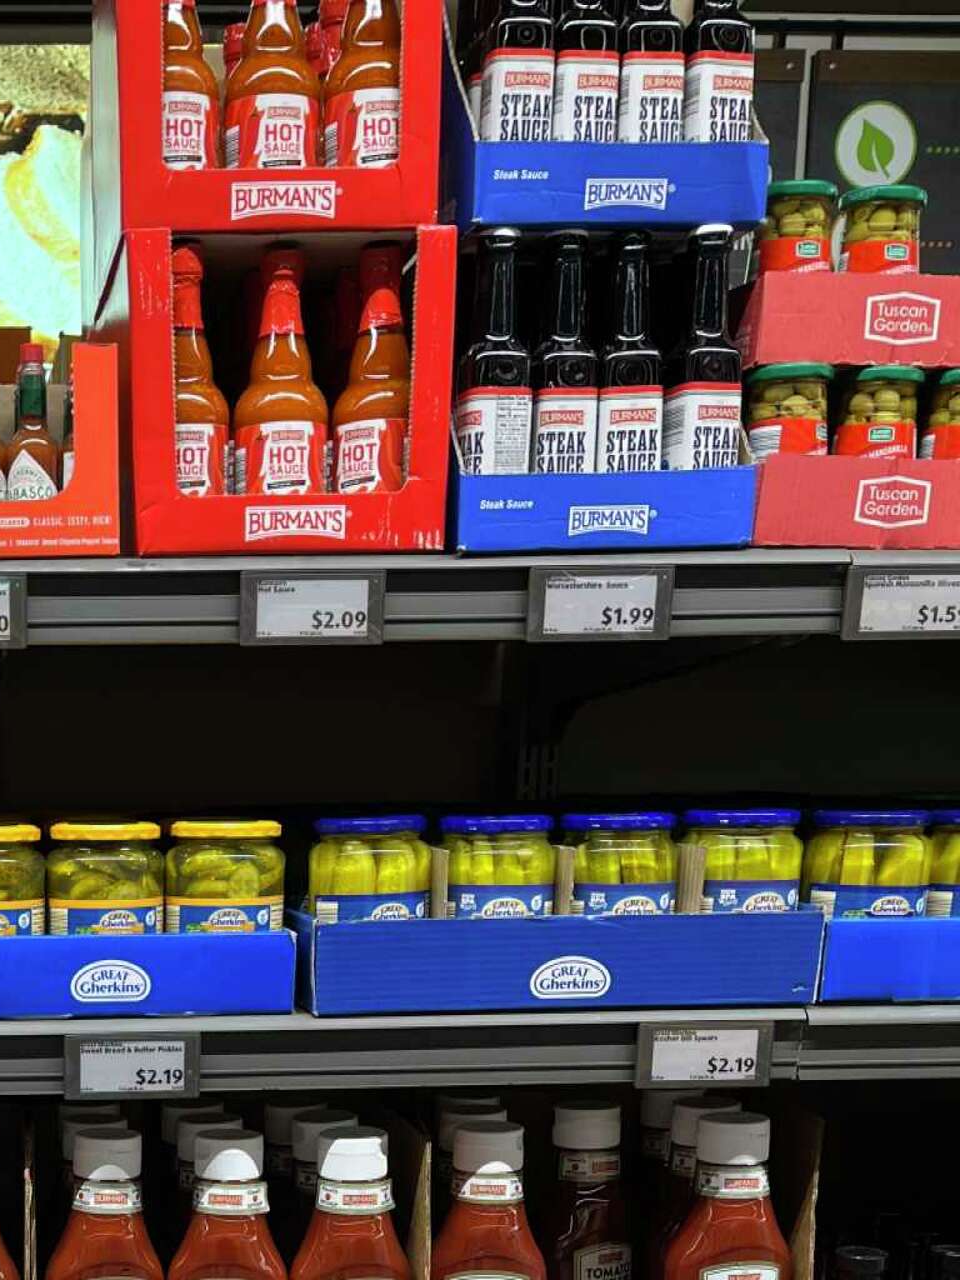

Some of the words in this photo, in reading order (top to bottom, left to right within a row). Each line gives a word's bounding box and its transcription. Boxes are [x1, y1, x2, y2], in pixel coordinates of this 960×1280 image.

[166, 120, 202, 135] HOT
[265, 125, 302, 141] HOT
[521, 170, 548, 179] Sauce
[235, 187, 332, 212] BURMAN'S
[589, 184, 664, 205] BURMAN'S
[878, 302, 927, 317] Tuscan
[874, 319, 928, 333] Garden
[537, 431, 586, 454] STEAK
[607, 430, 657, 453] STEAK
[694, 426, 740, 449] STEAK
[269, 446, 306, 463] HOT
[343, 443, 376, 461] HOT
[269, 464, 304, 475] SAUCE
[607, 454, 656, 473] SAUCE
[869, 486, 918, 501] Tuscan
[864, 502, 919, 516] Garden
[249, 510, 342, 534] BURMAN'S
[572, 510, 646, 531] BURMAN'S
[312, 612, 366, 629] $2.09
[601, 608, 653, 626] $1.99
[92, 971, 129, 982] GREAT
[552, 968, 589, 979] GREAT
[80, 982, 142, 995] Gherkins
[540, 978, 603, 990] Gherkins
[708, 1058, 754, 1074] $2.19
[136, 1069, 183, 1087] $2.19
